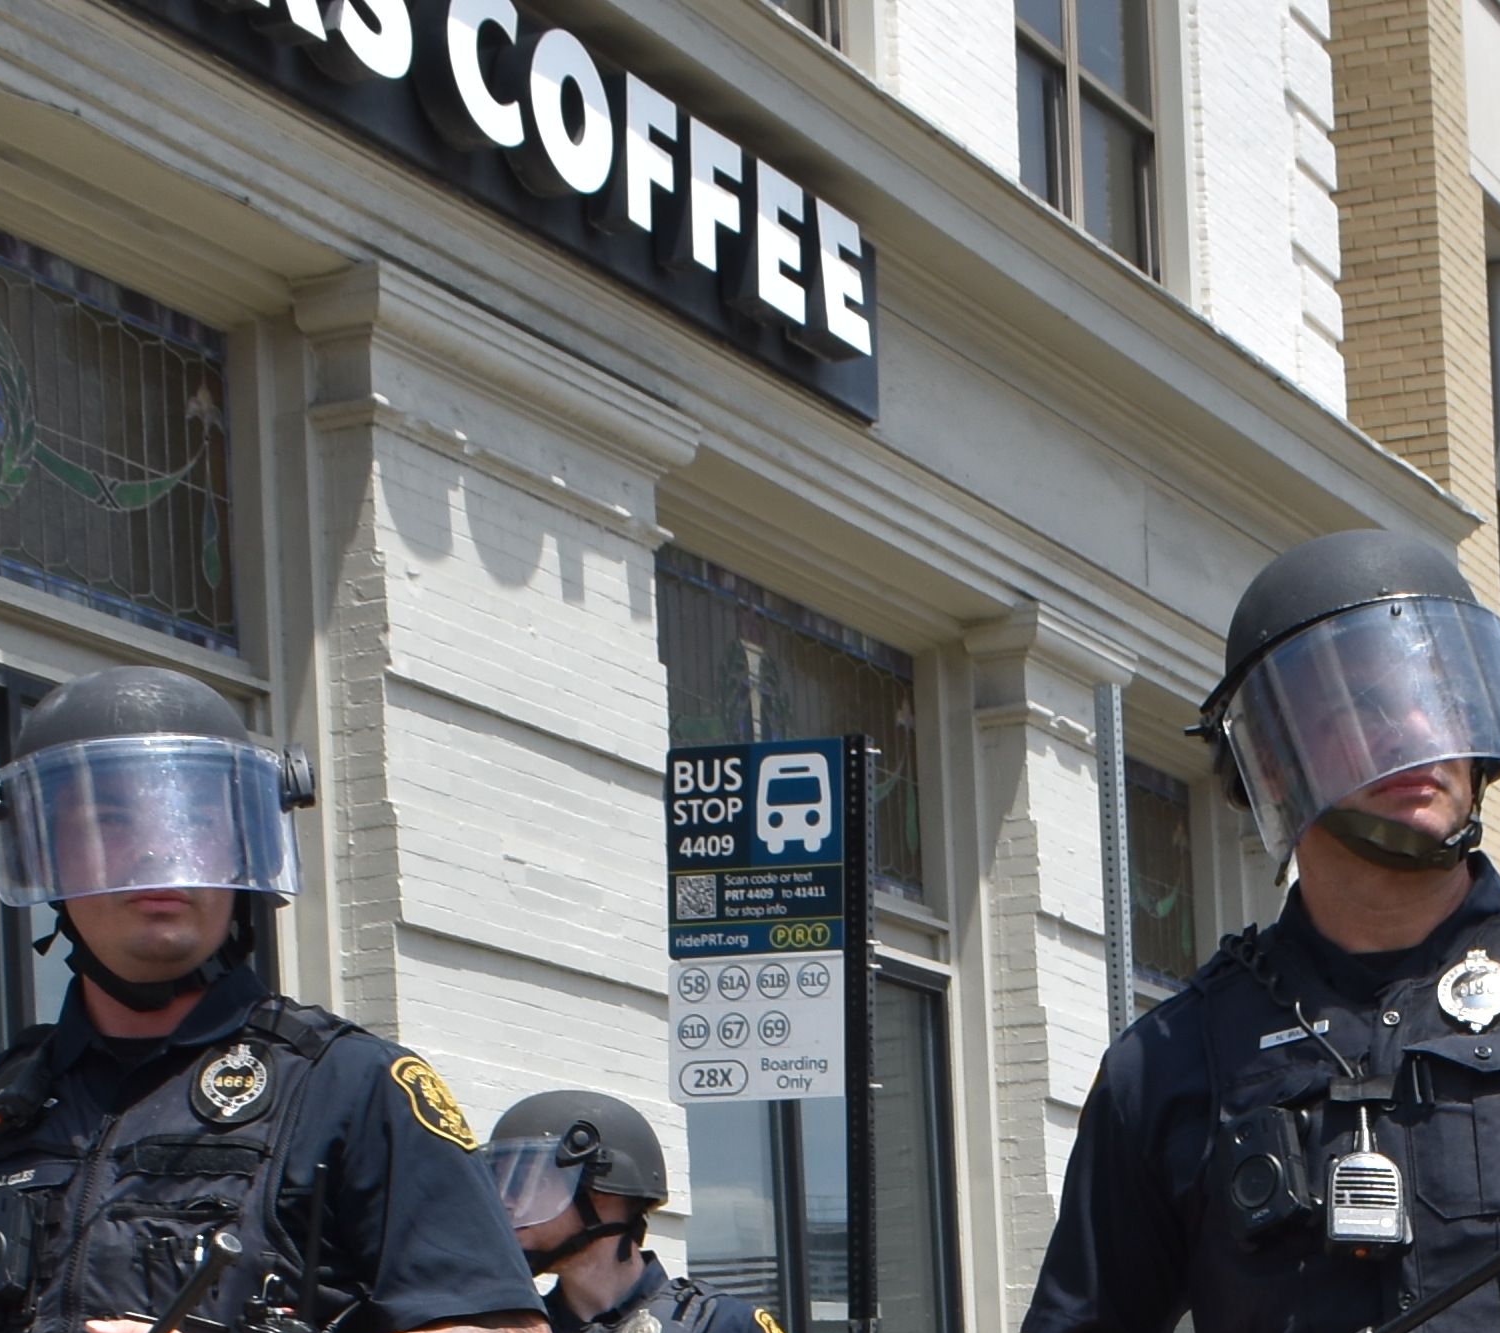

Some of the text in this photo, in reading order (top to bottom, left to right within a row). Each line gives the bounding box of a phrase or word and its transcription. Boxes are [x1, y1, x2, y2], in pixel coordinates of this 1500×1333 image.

[447, 0, 872, 358] COFFEE
[673, 757, 743, 795] BUS
[673, 798, 743, 826] STOP
[679, 835, 735, 858] 4409
[724, 874, 749, 886] Scan
[750, 872, 779, 885] code
[779, 874, 792, 884] or
[724, 886, 826, 902] PRT 4409 to 41411
[725, 902, 788, 918] for stop info
[675, 932, 749, 949] ridePRT.org
[682, 971, 828, 995] 58 61A 61B 61C
[681, 1018, 786, 1041] 61D 67 69
[760, 1056, 828, 1074] Boarding
[693, 1067, 733, 1089] 28X
[776, 1074, 813, 1092] Only
